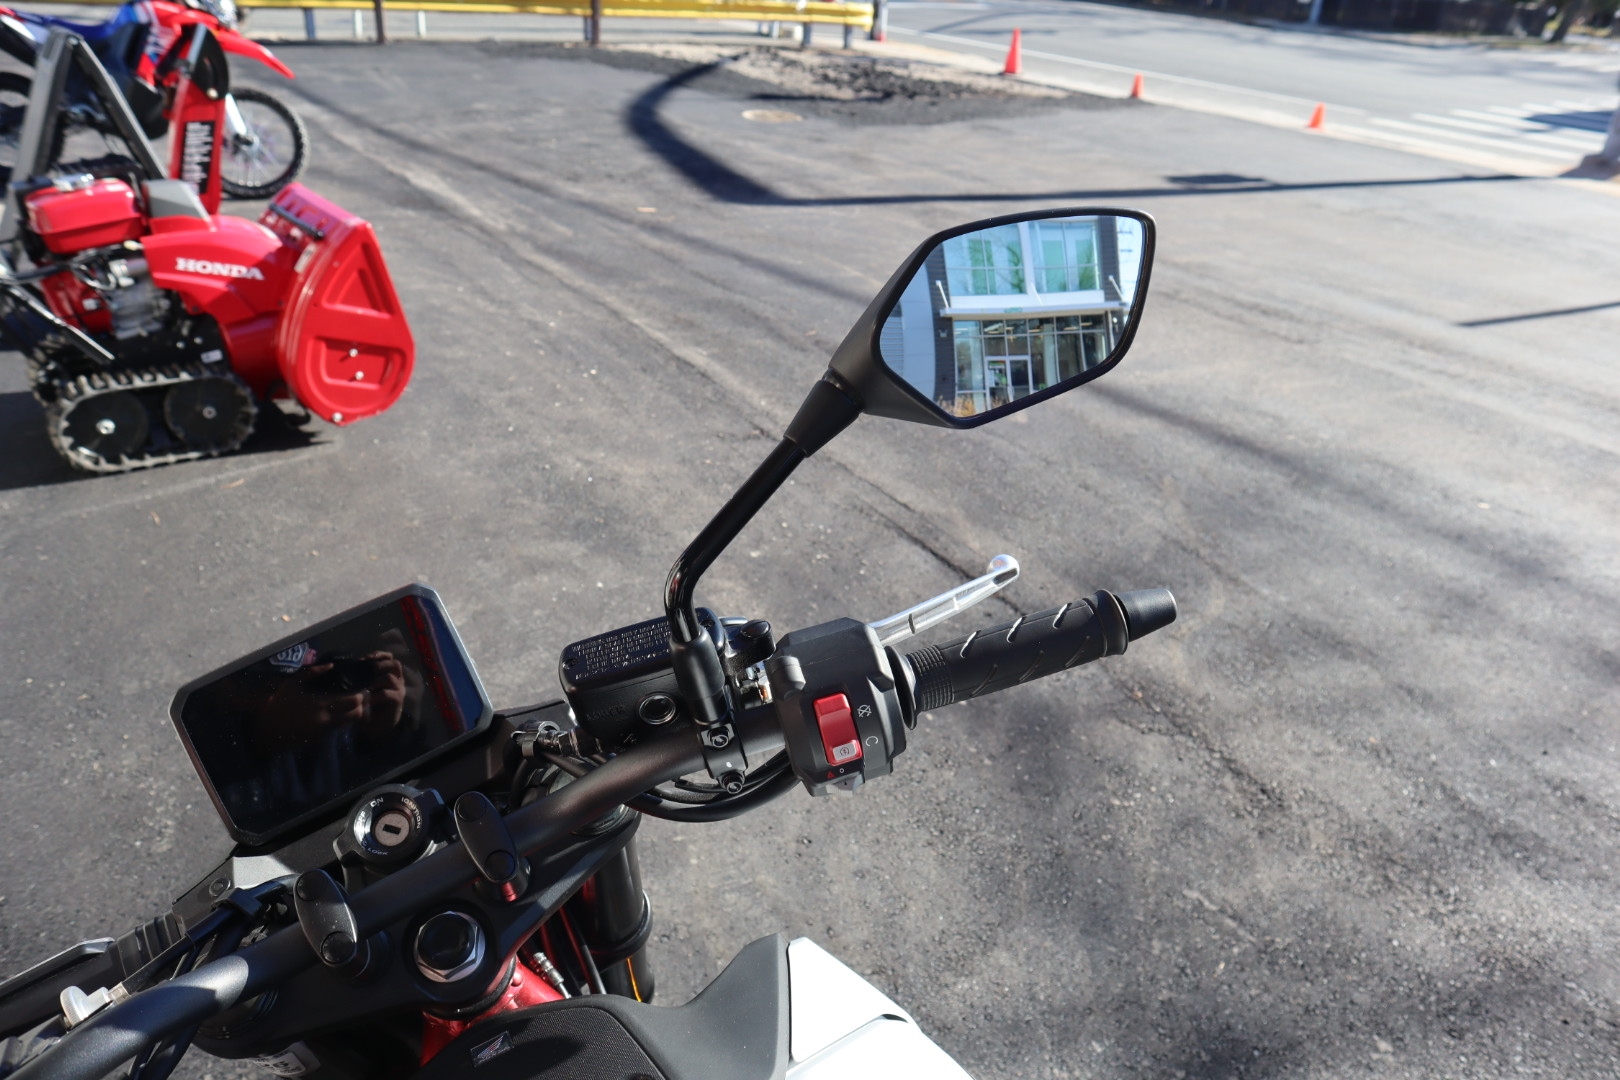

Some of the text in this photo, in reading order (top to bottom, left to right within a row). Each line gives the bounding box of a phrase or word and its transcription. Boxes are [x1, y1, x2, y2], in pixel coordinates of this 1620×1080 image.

[175, 257, 265, 281] HONDA
[370, 797, 384, 808] ON
[401, 796, 421, 829] IGNITION
